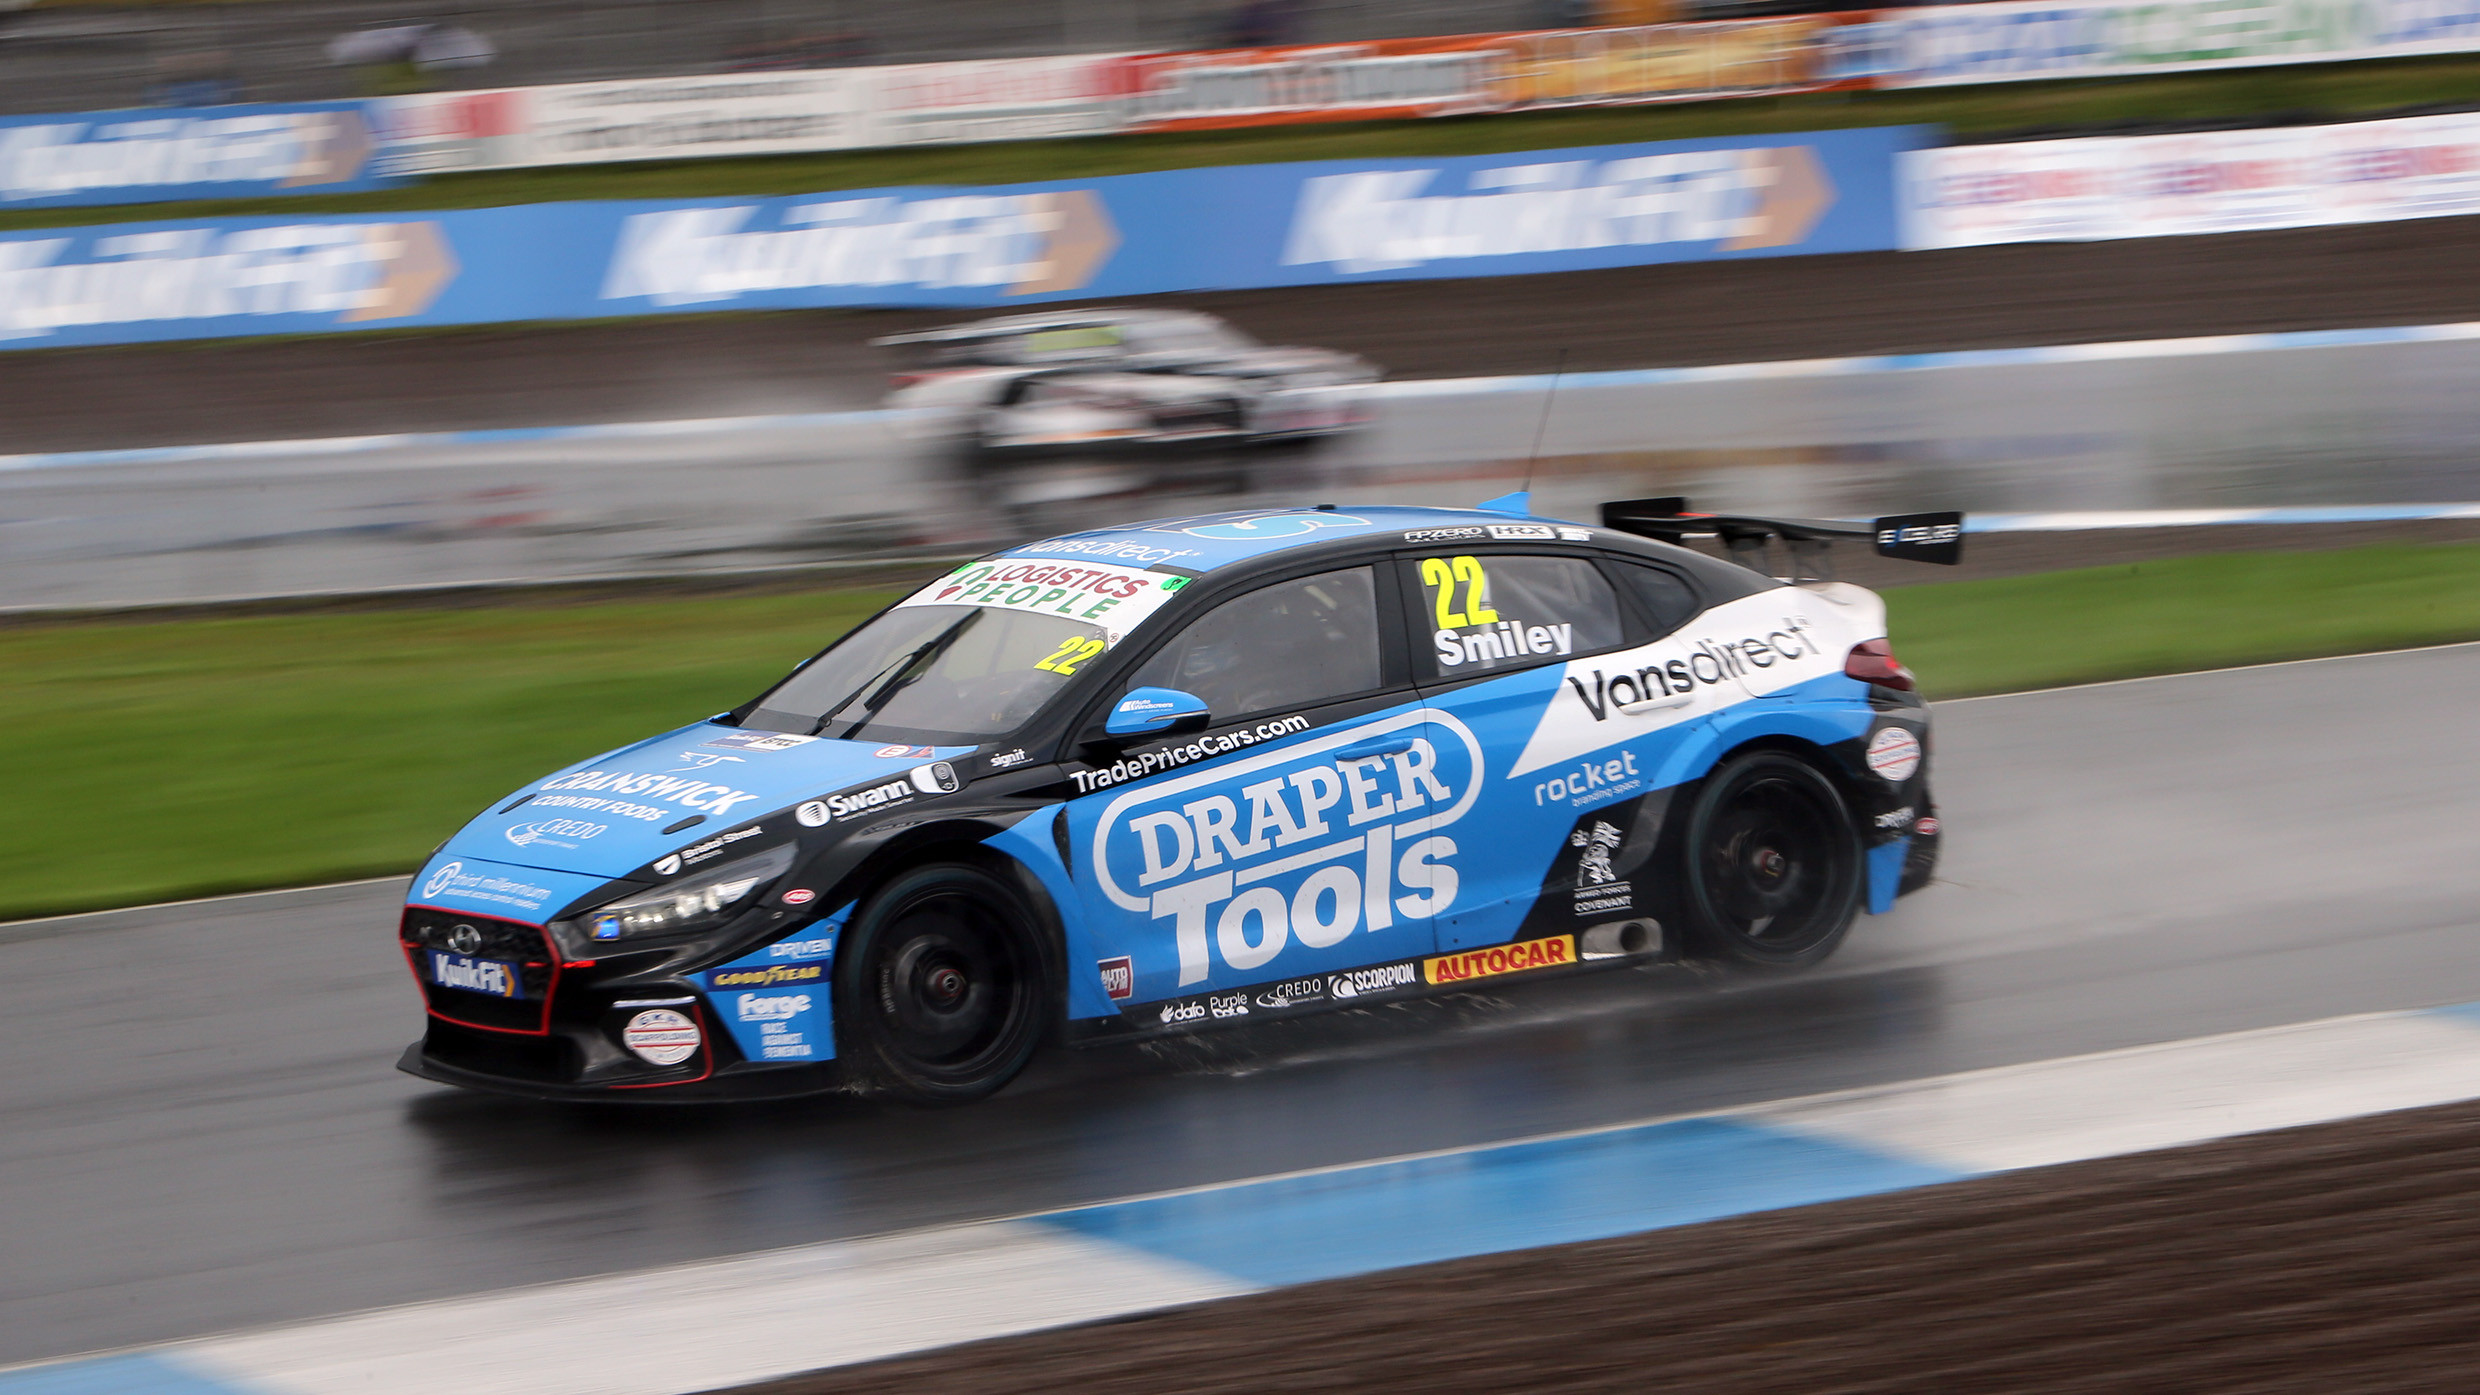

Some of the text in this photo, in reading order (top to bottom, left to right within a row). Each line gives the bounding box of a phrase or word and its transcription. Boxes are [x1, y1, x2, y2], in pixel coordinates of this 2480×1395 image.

[984, 564, 1150, 598] LOGISTICS
[1421, 555, 1500, 630] 22
[954, 583, 1122, 619] PEOPLE
[1033, 635, 1106, 676] 22
[1434, 620, 1573, 666] Smiley
[1567, 617, 1821, 722] Vansdirect
[990, 748, 1026, 768] signit
[1069, 712, 1311, 794] TradePriceCars.com
[540, 771, 760, 816] CRANSWICK
[1534, 750, 1640, 807] rocket
[532, 795, 670, 821] COUNTRY FOODS
[826, 780, 912, 817] Swann
[1128, 738, 1452, 888] DRAPER
[537, 818, 609, 840] CREDO
[1150, 823, 1460, 988] Tools
[714, 965, 822, 986] GOODYEAR
[1353, 963, 1416, 991] SCORPION
[1435, 938, 1567, 982] AUTOCAR
[737, 993, 812, 1020] Forge
[1210, 992, 1248, 1010] Purple
[1276, 978, 1322, 999] CREDO
[1174, 1001, 1206, 1020] dafo
